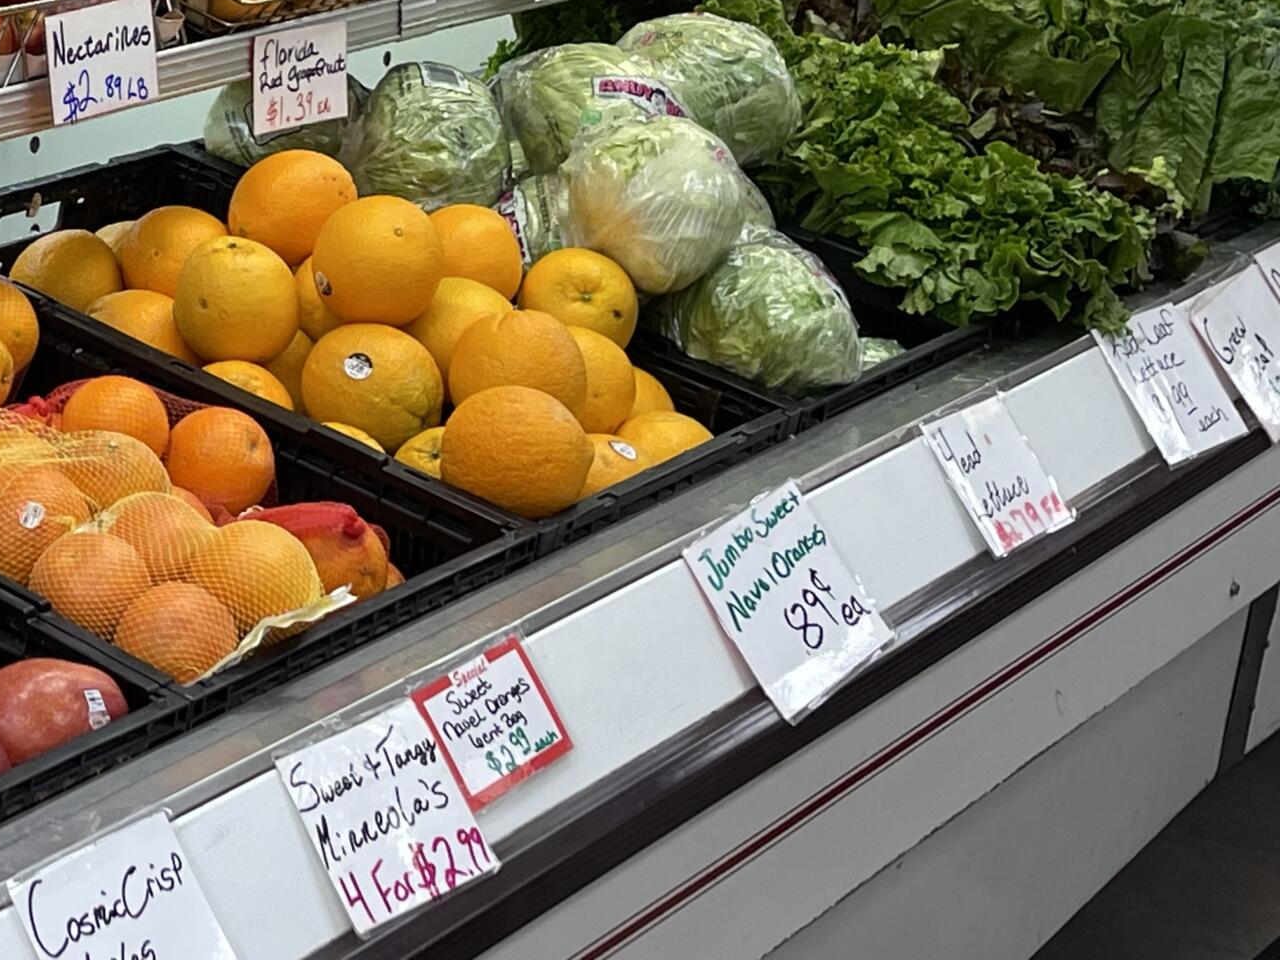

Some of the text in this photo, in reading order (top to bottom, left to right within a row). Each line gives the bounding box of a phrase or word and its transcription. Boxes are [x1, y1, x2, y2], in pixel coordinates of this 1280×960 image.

[53, 20, 151, 68] Nectarines
[127, 77, 148, 100] LB
[698, 491, 800, 591] Jumbo Sweet
[446, 678, 492, 715] Sweet
[453, 659, 487, 688] Special
[290, 762, 363, 813] Sweet
[375, 724, 437, 777] Tangy
[339, 871, 376, 923] 4
[371, 858, 415, 913] For
